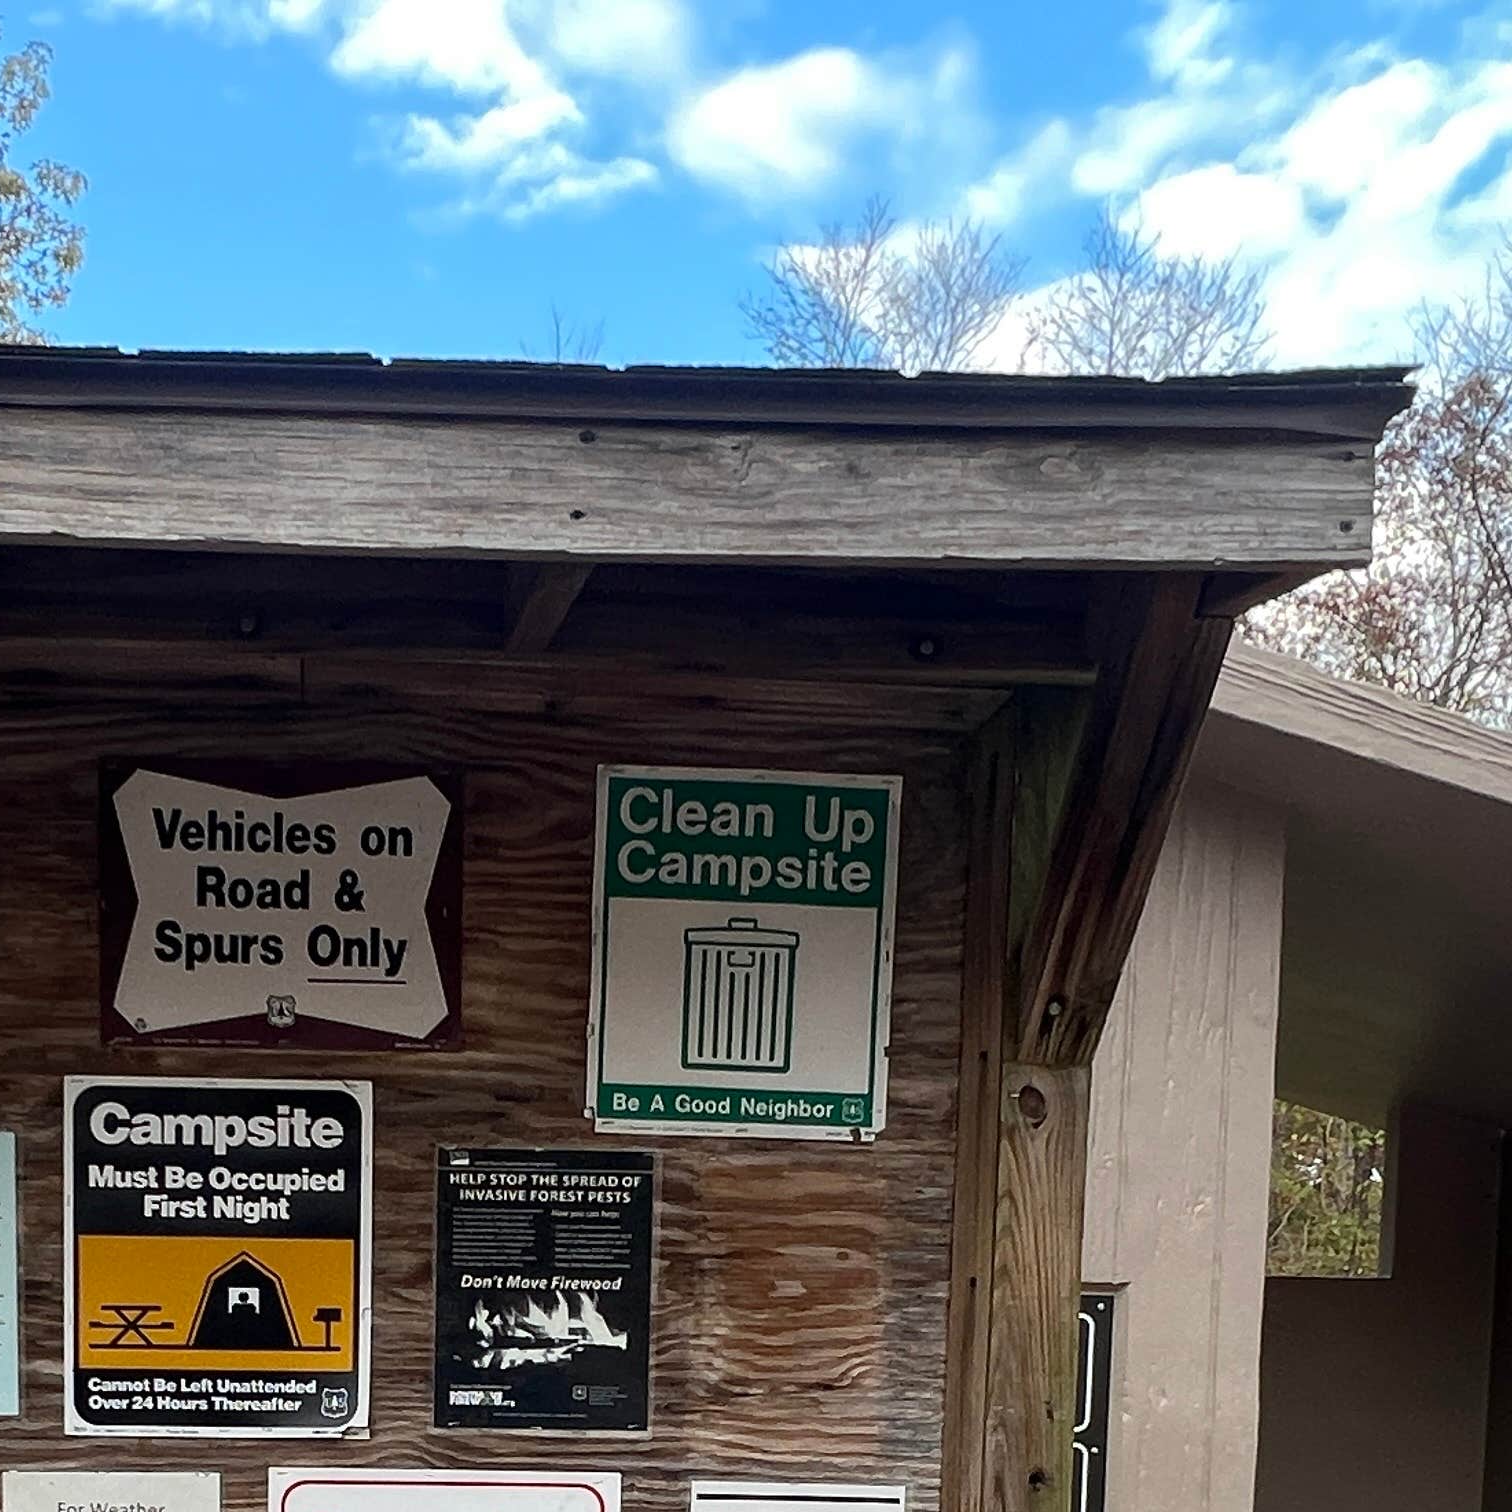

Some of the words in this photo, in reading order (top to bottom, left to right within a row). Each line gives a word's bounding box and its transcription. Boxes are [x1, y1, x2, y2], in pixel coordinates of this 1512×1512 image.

[152, 807, 336, 855] Vehicles
[360, 826, 413, 856] on
[620, 786, 774, 838] Clean
[804, 796, 874, 852] Up
[618, 840, 871, 896] Campsite
[196, 865, 310, 910] Road
[335, 869, 366, 912] &
[154, 920, 284, 970] Spurs
[307, 925, 408, 977] Only
[612, 1093, 640, 1112] Be
[650, 1094, 665, 1112] A
[675, 1094, 730, 1115] Good
[741, 1098, 834, 1121] Neighbor
[90, 1101, 344, 1155] Campsite
[88, 1165, 158, 1189] Must
[164, 1166, 203, 1189] Be
[209, 1168, 344, 1195] Occupied
[450, 1173, 486, 1186] HELP
[490, 1174, 527, 1186] STOP
[532, 1174, 558, 1186] THE
[562, 1175, 619, 1187] SPREAD
[622, 1176, 642, 1188] OF
[144, 1194, 206, 1218] First
[213, 1196, 290, 1223] Night
[460, 1189, 526, 1201] INVASIVE
[530, 1190, 584, 1202] FOREST
[588, 1191, 632, 1203] PESTS
[461, 1274, 504, 1289] Don't
[507, 1276, 547, 1290] Move
[550, 1276, 622, 1290] Firewood
[88, 1377, 150, 1393] Cannot
[154, 1378, 176, 1393] Be
[180, 1378, 214, 1393] Left
[217, 1378, 316, 1394] Unattended
[88, 1396, 128, 1410] Over
[132, 1396, 153, 1410] 24
[157, 1396, 208, 1411] Hours
[212, 1396, 302, 1412] Thereafter
